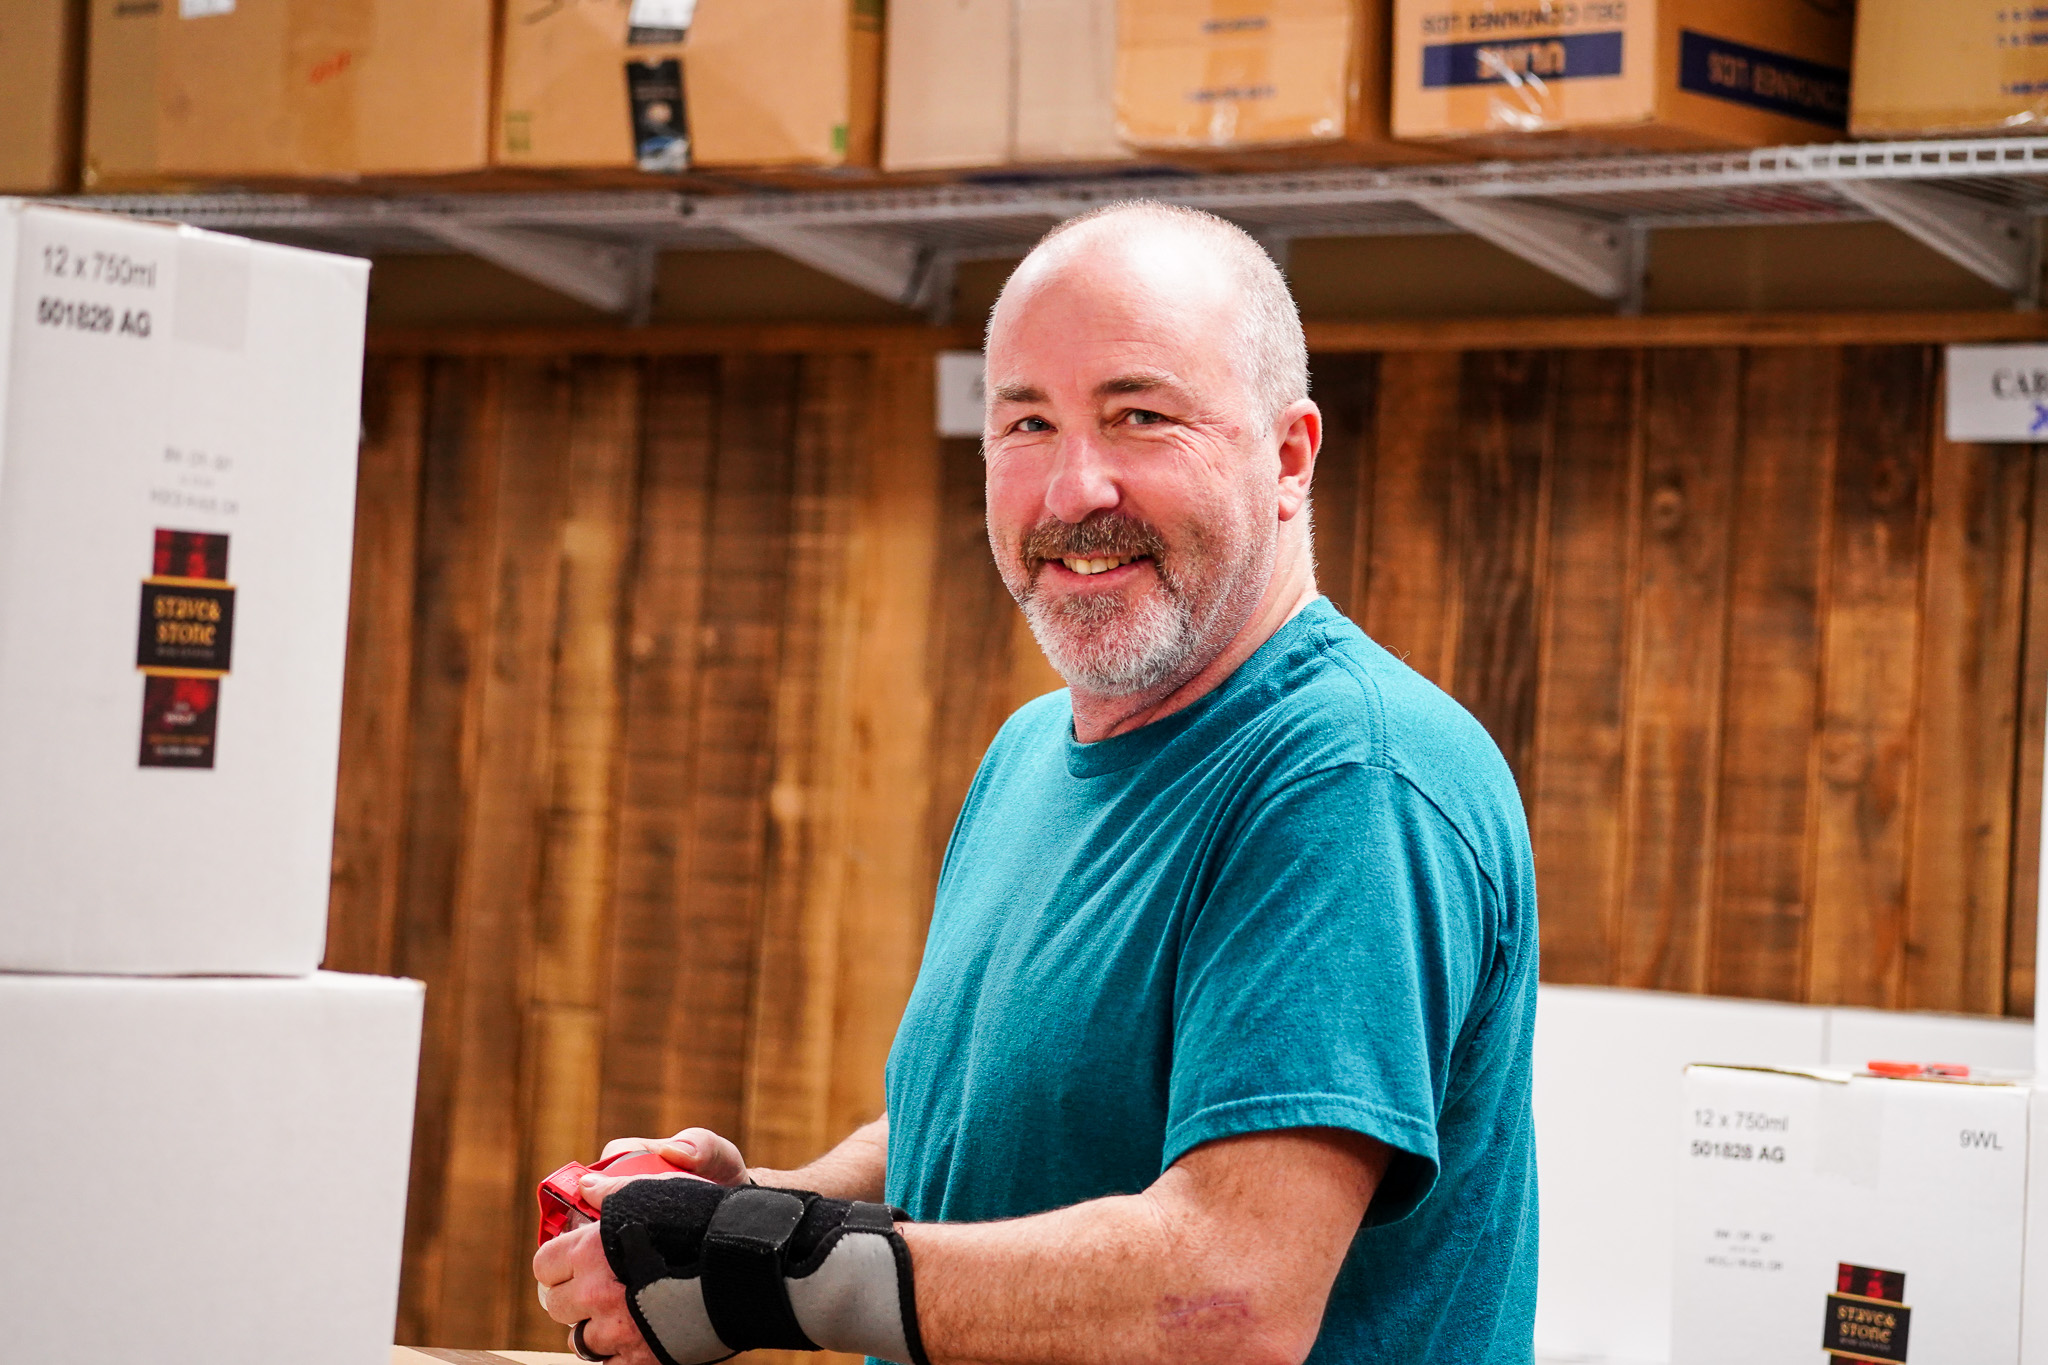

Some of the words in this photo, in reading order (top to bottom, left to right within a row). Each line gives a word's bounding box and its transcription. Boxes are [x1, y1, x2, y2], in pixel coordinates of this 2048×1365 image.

[43, 246, 67, 277] 12
[74, 257, 87, 279] x
[93, 252, 157, 289] 750ml
[120, 310, 151, 338] AG
[1695, 1109, 1714, 1128] 12
[1719, 1114, 1729, 1129] x
[1735, 1110, 1789, 1132] 750ml
[1959, 1129, 2003, 1151] 9WL
[1758, 1145, 1785, 1164] AG
